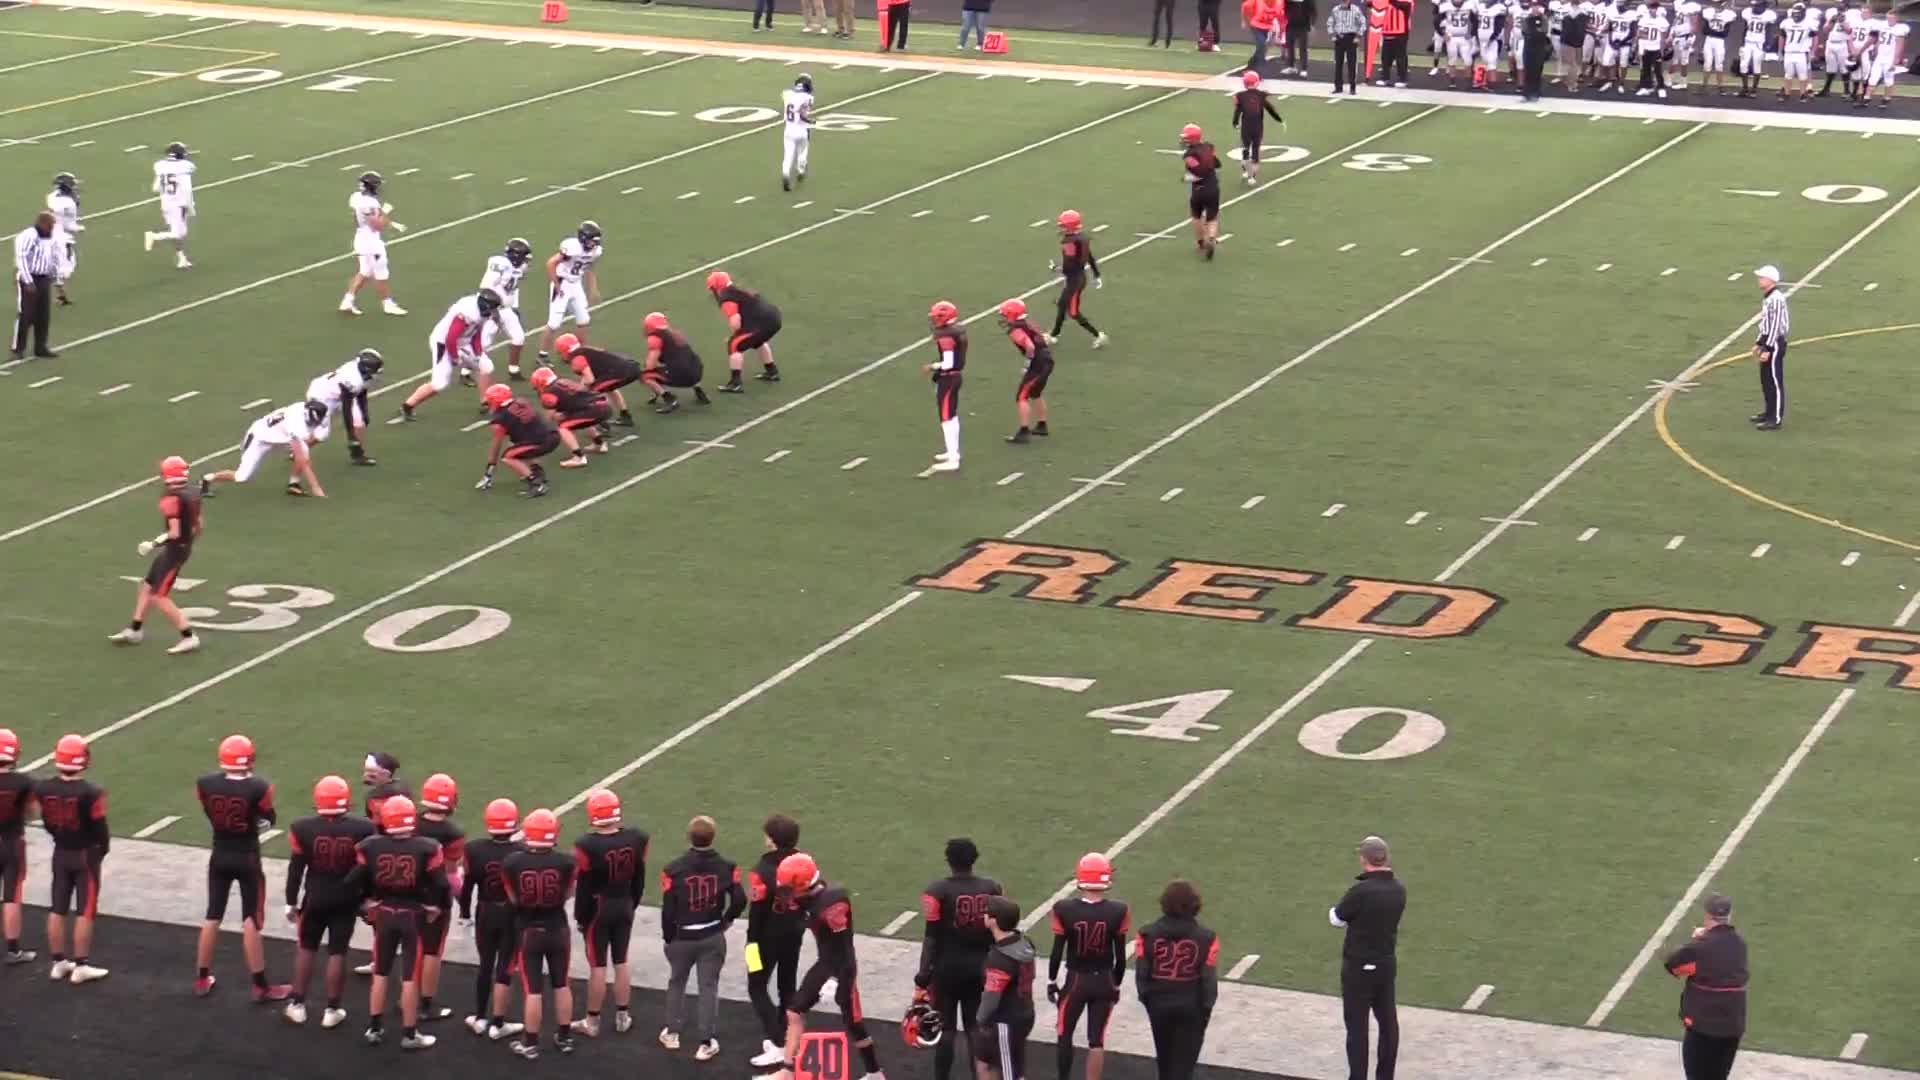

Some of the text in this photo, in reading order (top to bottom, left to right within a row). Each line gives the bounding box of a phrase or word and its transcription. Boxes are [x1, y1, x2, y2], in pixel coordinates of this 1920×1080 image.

[546, 4, 560, 18] 10
[786, 103, 795, 122] 6
[904, 538, 1508, 639] RED
[519, 868, 561, 906] 96
[684, 874, 719, 912] 11
[1073, 920, 1107, 956] 14
[1151, 938, 1200, 981] 22
[800, 1038, 843, 1080] 40
